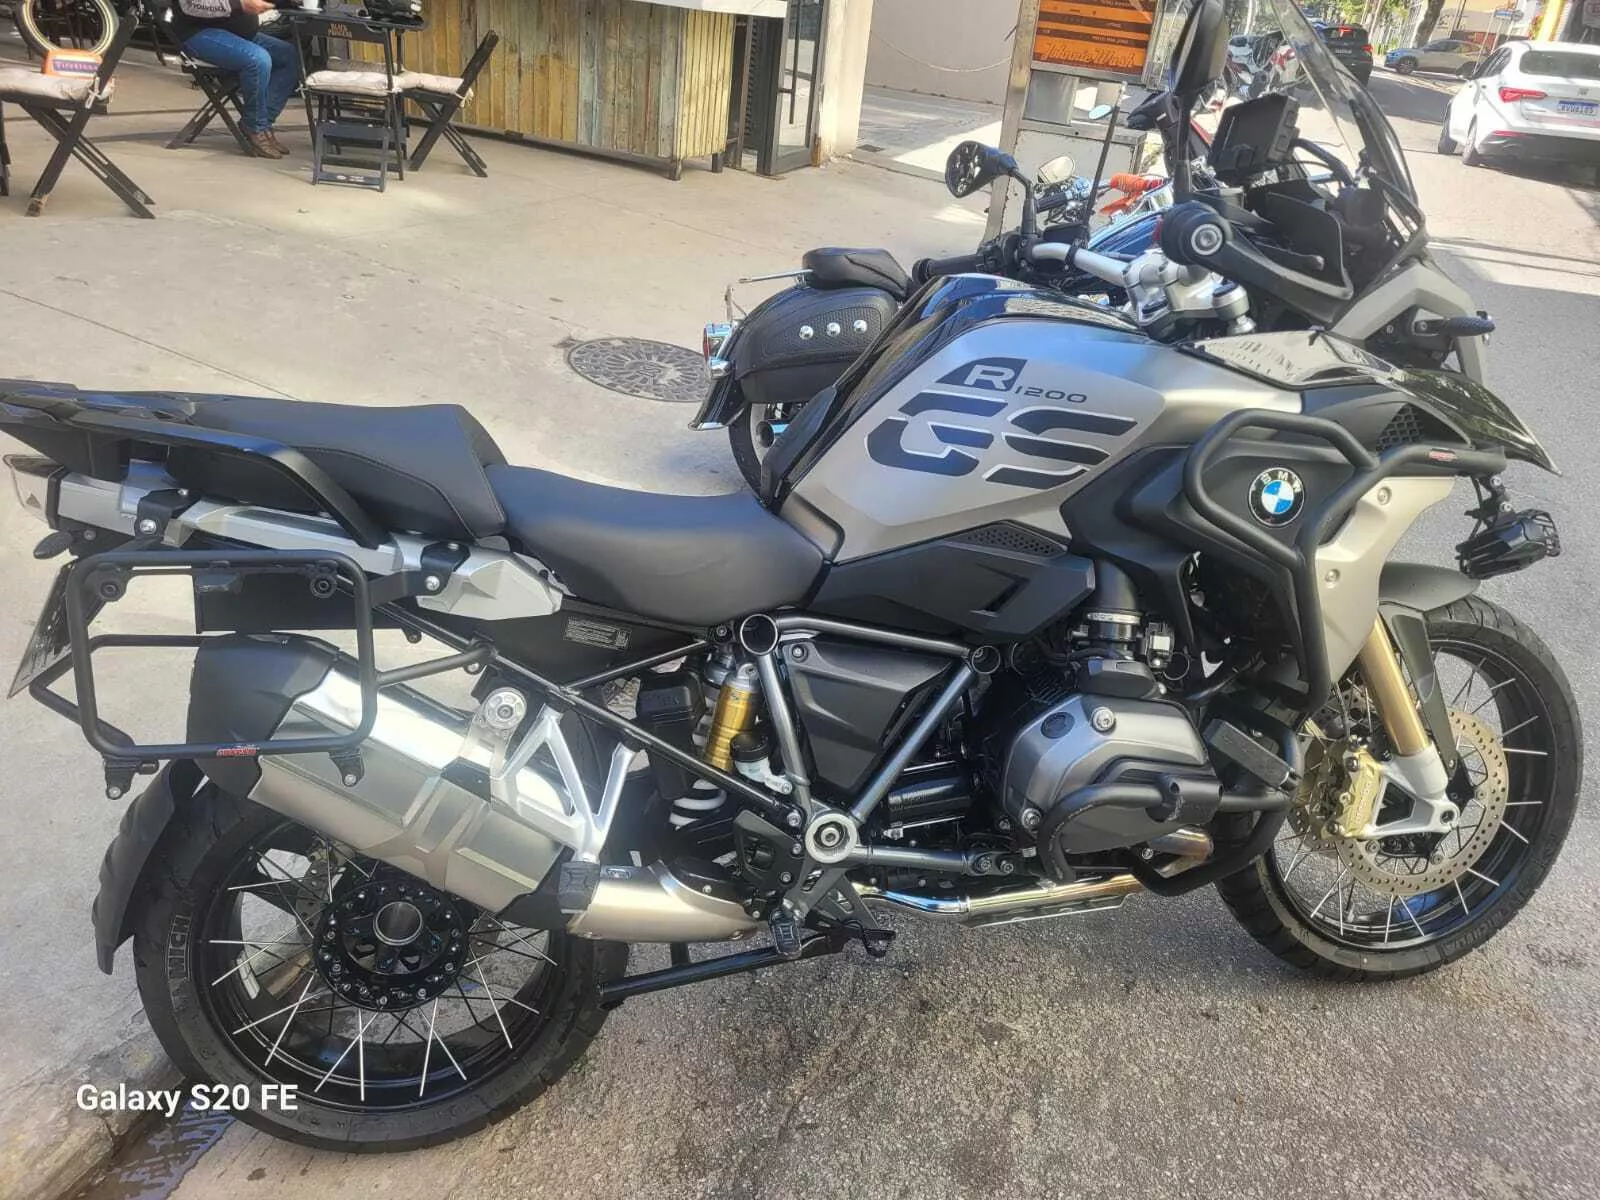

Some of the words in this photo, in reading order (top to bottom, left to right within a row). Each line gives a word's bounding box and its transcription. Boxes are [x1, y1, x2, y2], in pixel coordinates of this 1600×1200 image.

[1015, 385, 1088, 404] 1200
[864, 389, 1139, 490] GS
[1260, 470, 1302, 493] BMW
